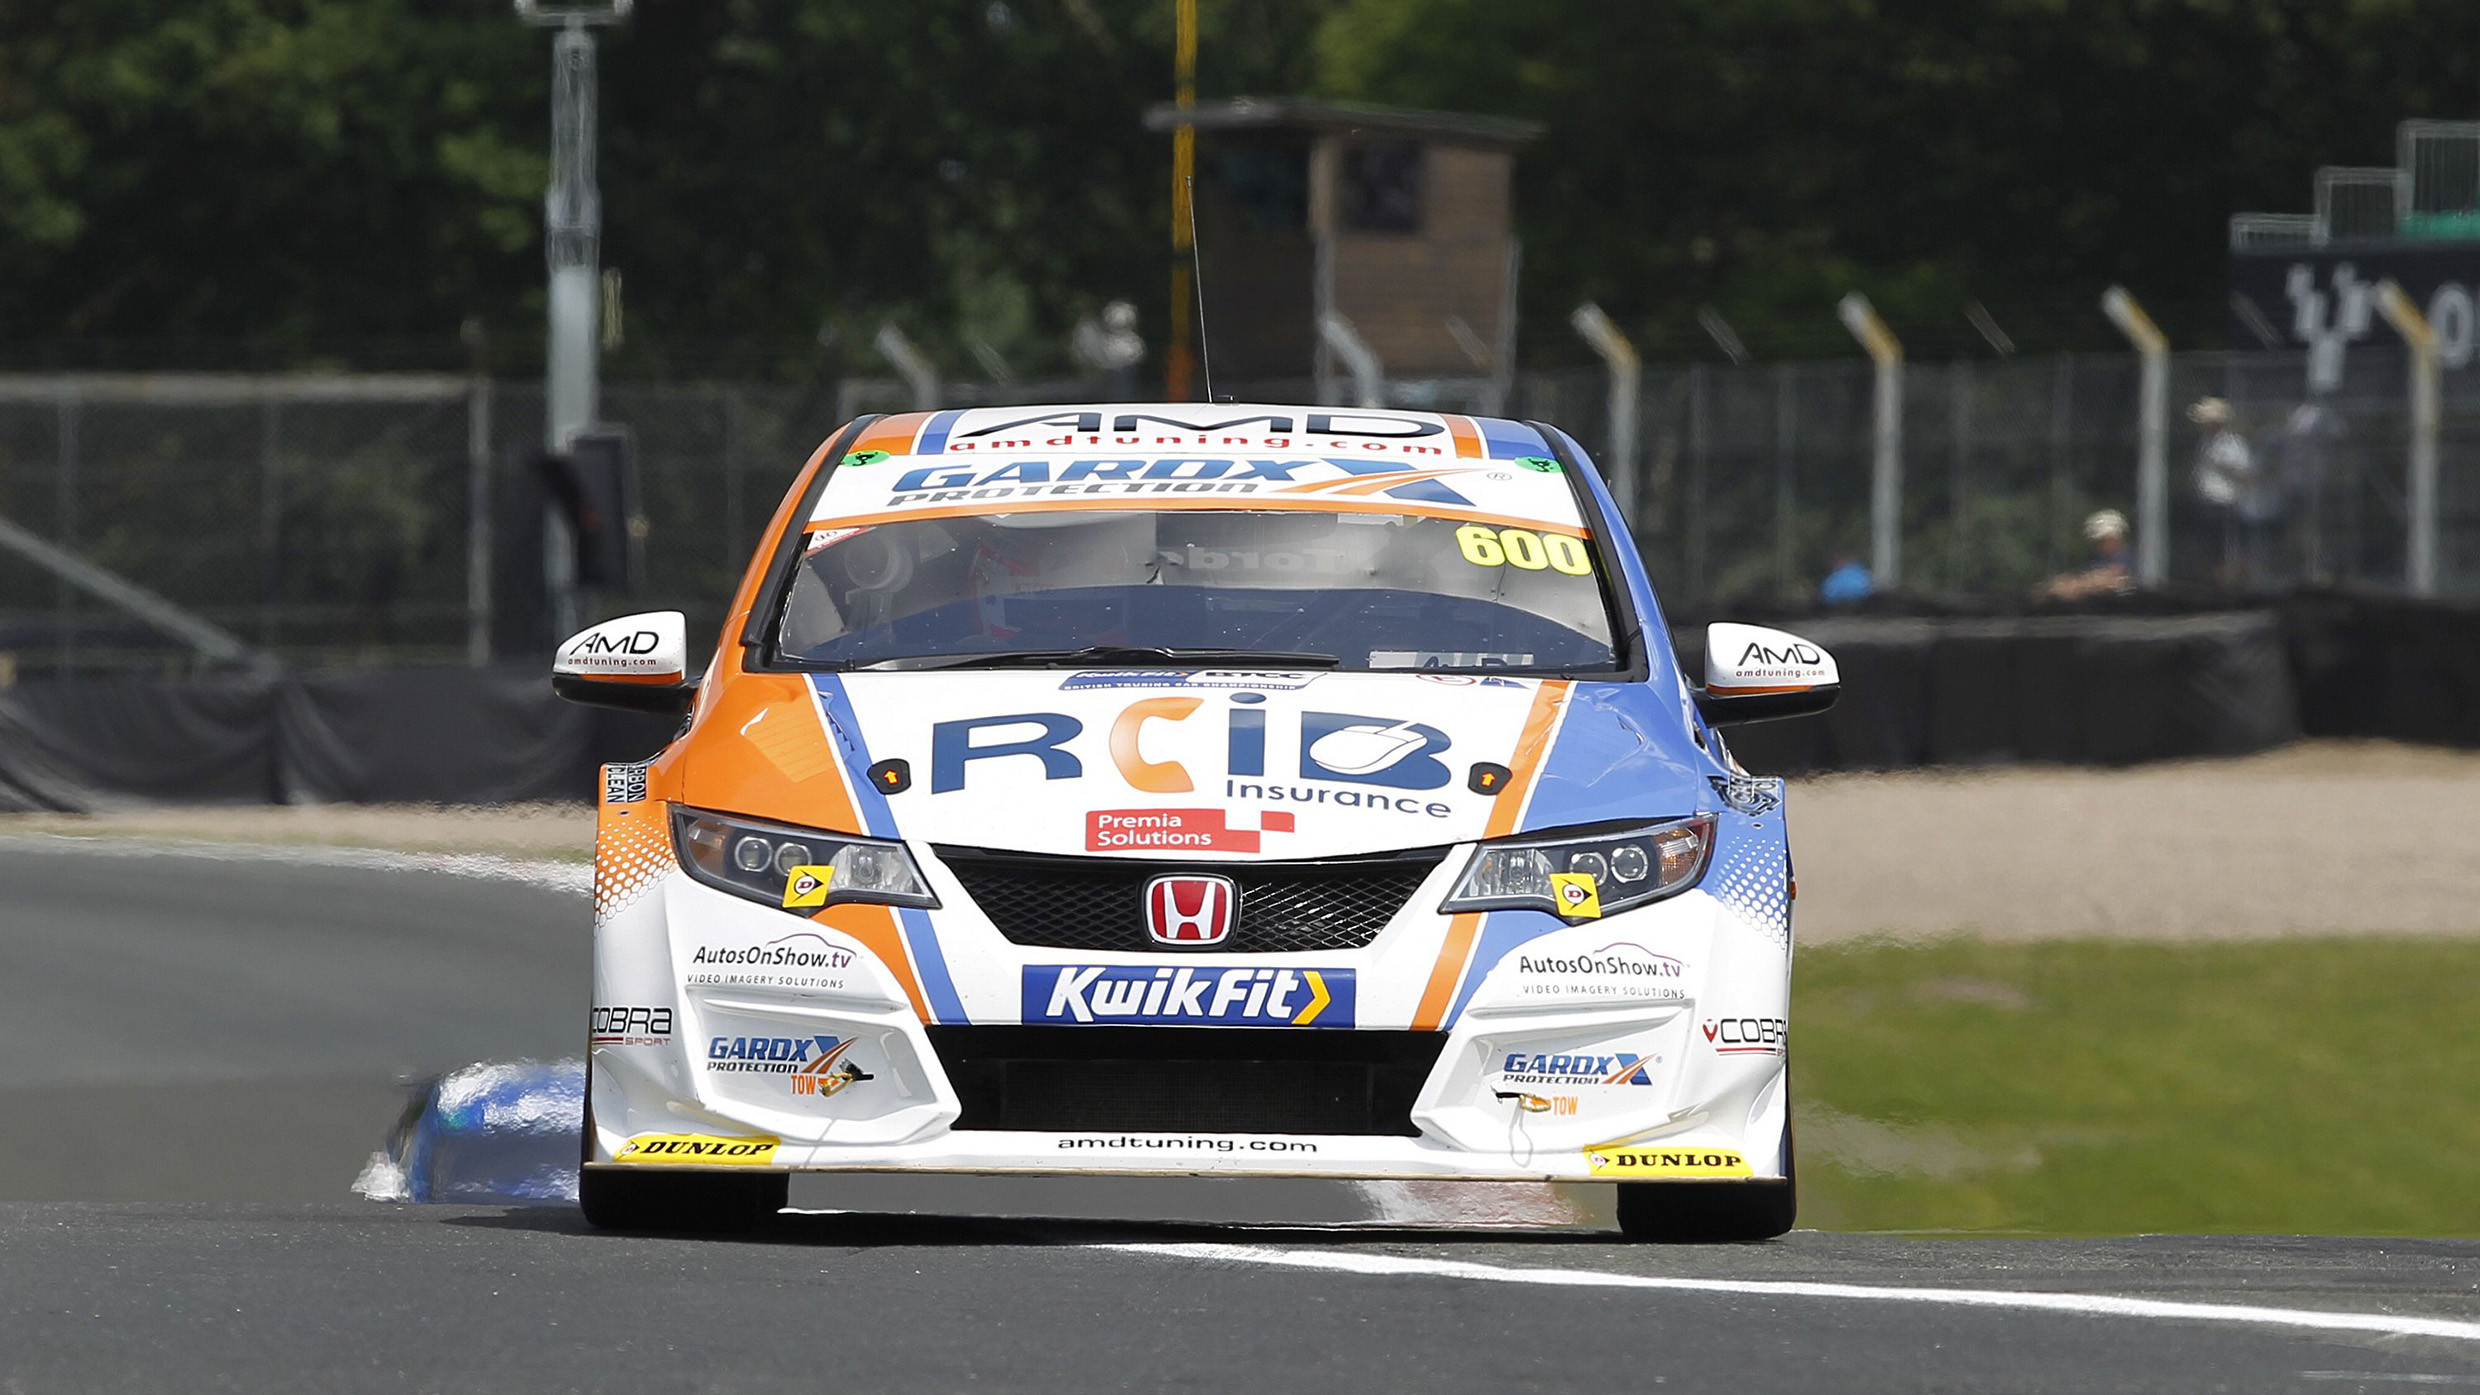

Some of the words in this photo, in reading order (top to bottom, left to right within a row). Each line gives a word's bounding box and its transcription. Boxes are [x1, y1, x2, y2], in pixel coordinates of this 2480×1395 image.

[955, 412, 1445, 438] AMD
[950, 434, 1441, 455] amdtuning.com
[1455, 525, 1592, 576] 600
[569, 631, 659, 656] AMD
[568, 657, 657, 667] amdtuning.com
[1738, 642, 1820, 666] AMD
[1736, 668, 1825, 678] amdtuning.com
[1203, 682, 1297, 690] CHAMPIONSHIP
[607, 766, 625, 803] CLEAN
[1226, 779, 1451, 818] Insurance
[1097, 813, 1182, 828] Premia
[1097, 830, 1212, 846] Solutions
[692, 945, 852, 969] AutosOnShow.tv
[1520, 955, 1681, 977] AutosOnShow.tv
[687, 974, 721, 984] VIDEO
[724, 974, 774, 985] IMAGERY
[778, 976, 845, 989] SOLUTIONS
[1523, 985, 1561, 994] VIDEO
[1566, 985, 1617, 996] IMAGERY
[1623, 986, 1685, 999] SOLUTIONS
[625, 1036, 671, 1046] SPORT
[708, 1036, 814, 1062] GARDX
[1503, 1052, 1611, 1075] GARDX
[790, 1074, 817, 1095] TOW
[1553, 1096, 1578, 1115] TOW
[640, 1141, 774, 1157] DUNLOP
[1058, 1136, 1318, 1152] amdtuning.com
[1616, 1154, 1742, 1167] DUNLOP
